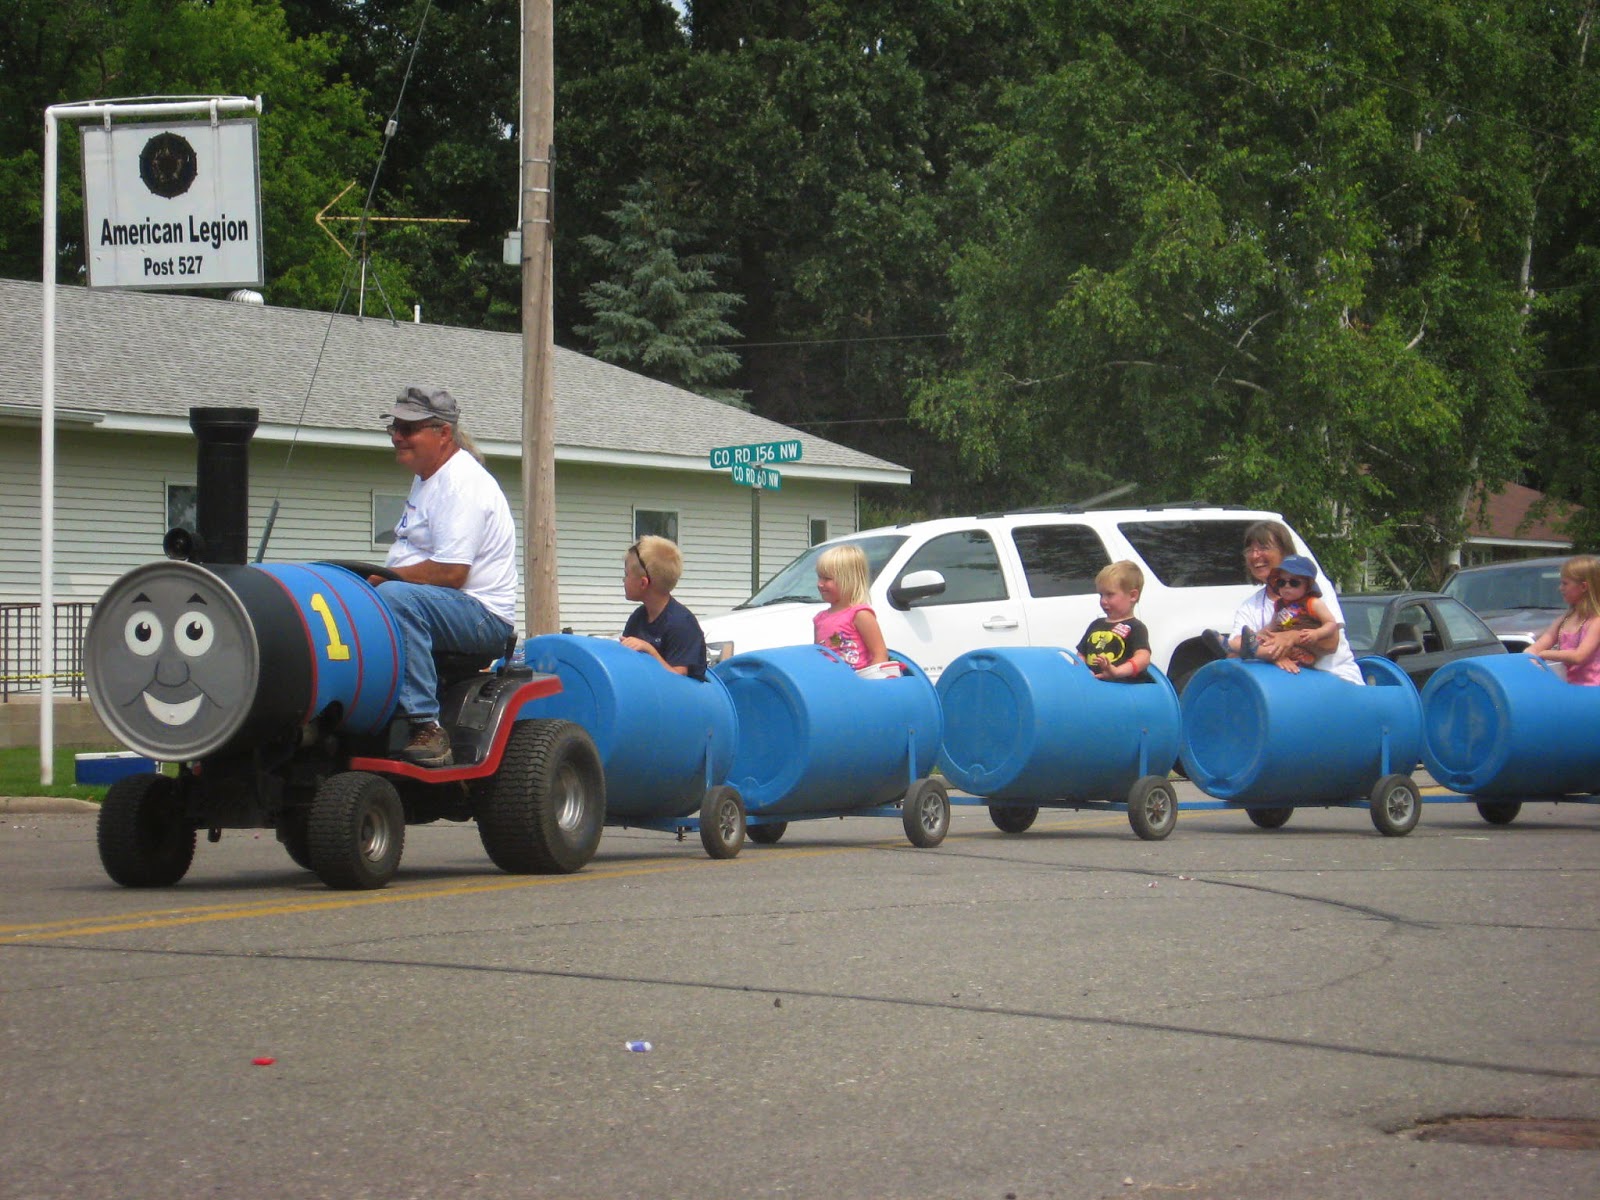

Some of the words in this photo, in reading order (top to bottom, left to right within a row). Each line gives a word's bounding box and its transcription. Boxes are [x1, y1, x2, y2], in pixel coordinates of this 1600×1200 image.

[100, 217, 183, 246] American
[188, 214, 249, 249] Legion
[144, 257, 174, 276] Post
[178, 255, 203, 275] 527
[714, 450, 730, 466] CO
[735, 448, 751, 463] RD
[755, 445, 775, 462] 156
[780, 443, 798, 459] NW
[733, 466, 744, 482] CO
[746, 468, 755, 484] RD
[757, 471, 767, 486] 60
[768, 472, 779, 488] NW
[310, 593, 350, 660] 1
